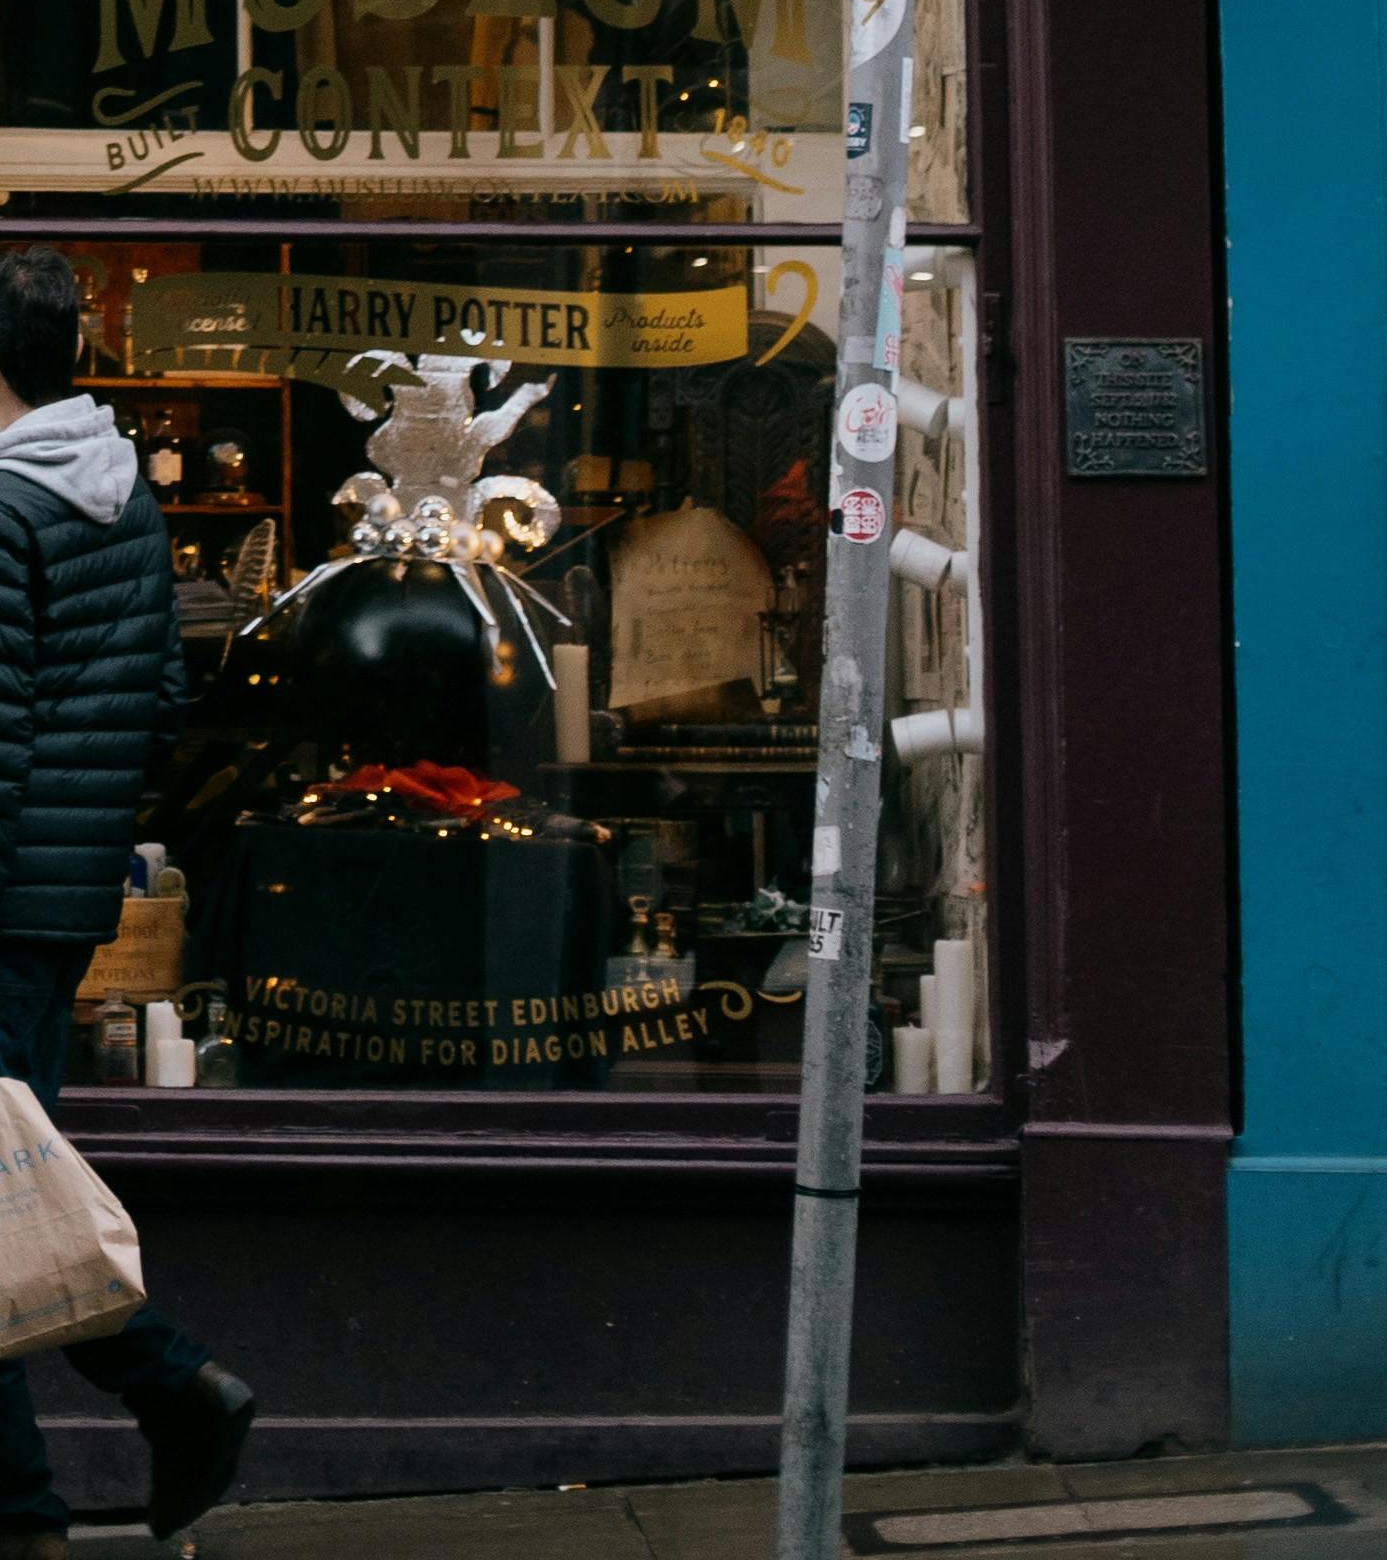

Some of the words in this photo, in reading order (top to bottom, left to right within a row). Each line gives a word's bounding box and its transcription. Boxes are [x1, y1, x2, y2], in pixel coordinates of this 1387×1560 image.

[106, 107, 200, 171] BUILT
[230, 65, 673, 161] CONTEXT
[714, 108, 791, 168] 1840
[279, 286, 417, 340] HARRY
[434, 296, 591, 350] POTTER
[245, 976, 376, 1023] VICTORIA
[393, 999, 499, 1027] STREET
[511, 978, 680, 1026] EDINBURGH
[422, 1038, 477, 1066] FOR
[492, 1030, 608, 1066] DIAGON
[621, 1008, 709, 1053] ALLEY
